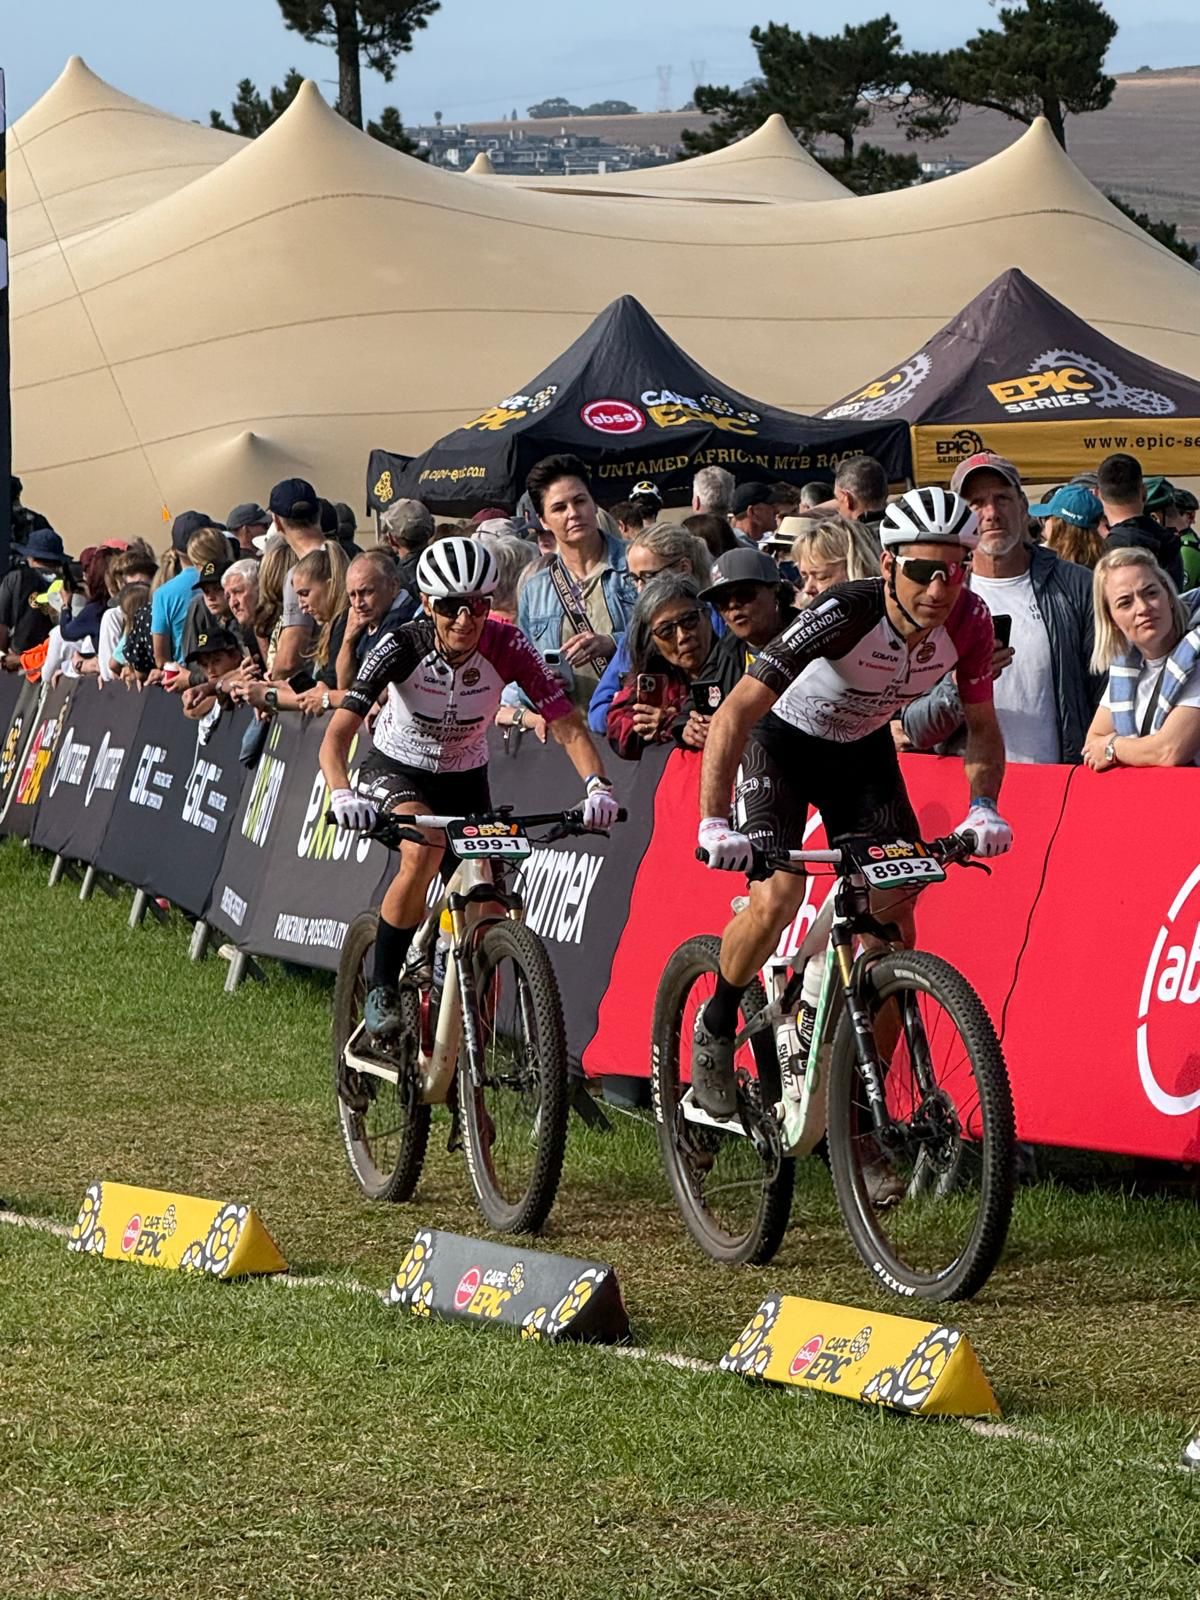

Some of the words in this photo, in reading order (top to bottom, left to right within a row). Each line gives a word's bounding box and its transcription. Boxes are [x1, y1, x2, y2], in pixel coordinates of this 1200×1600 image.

[987, 367, 1095, 405] EPIC
[591, 412, 636, 425] absa
[647, 404, 759, 436] EPIC
[1004, 393, 1091, 415] SERIES
[936, 440, 973, 456] EPIC
[599, 455, 689, 478] UNTAMED
[774, 455, 811, 470] MTB
[788, 608, 846, 650] MEERENDAL
[360, 638, 399, 682] MEERENDAL
[463, 839, 520, 850] 899-1
[479, 828, 507, 836] EPIC
[884, 848, 914, 858] EPIC
[872, 860, 936, 879] 899-2
[273, 913, 309, 945] POWERING
[305, 918, 349, 951] POSSIBILITY
[651, 1044, 664, 1123] MAXXIS
[860, 1063, 882, 1111] FOX
[460, 1107, 476, 1175] PIRELLI
[135, 1230, 167, 1257] EPIC
[483, 1269, 508, 1288] CAPE
[873, 1262, 916, 1296] MAXXIS
[467, 1284, 511, 1318] EPIC
[825, 1336, 851, 1351] CAPE
[804, 1351, 852, 1384] EPIC
